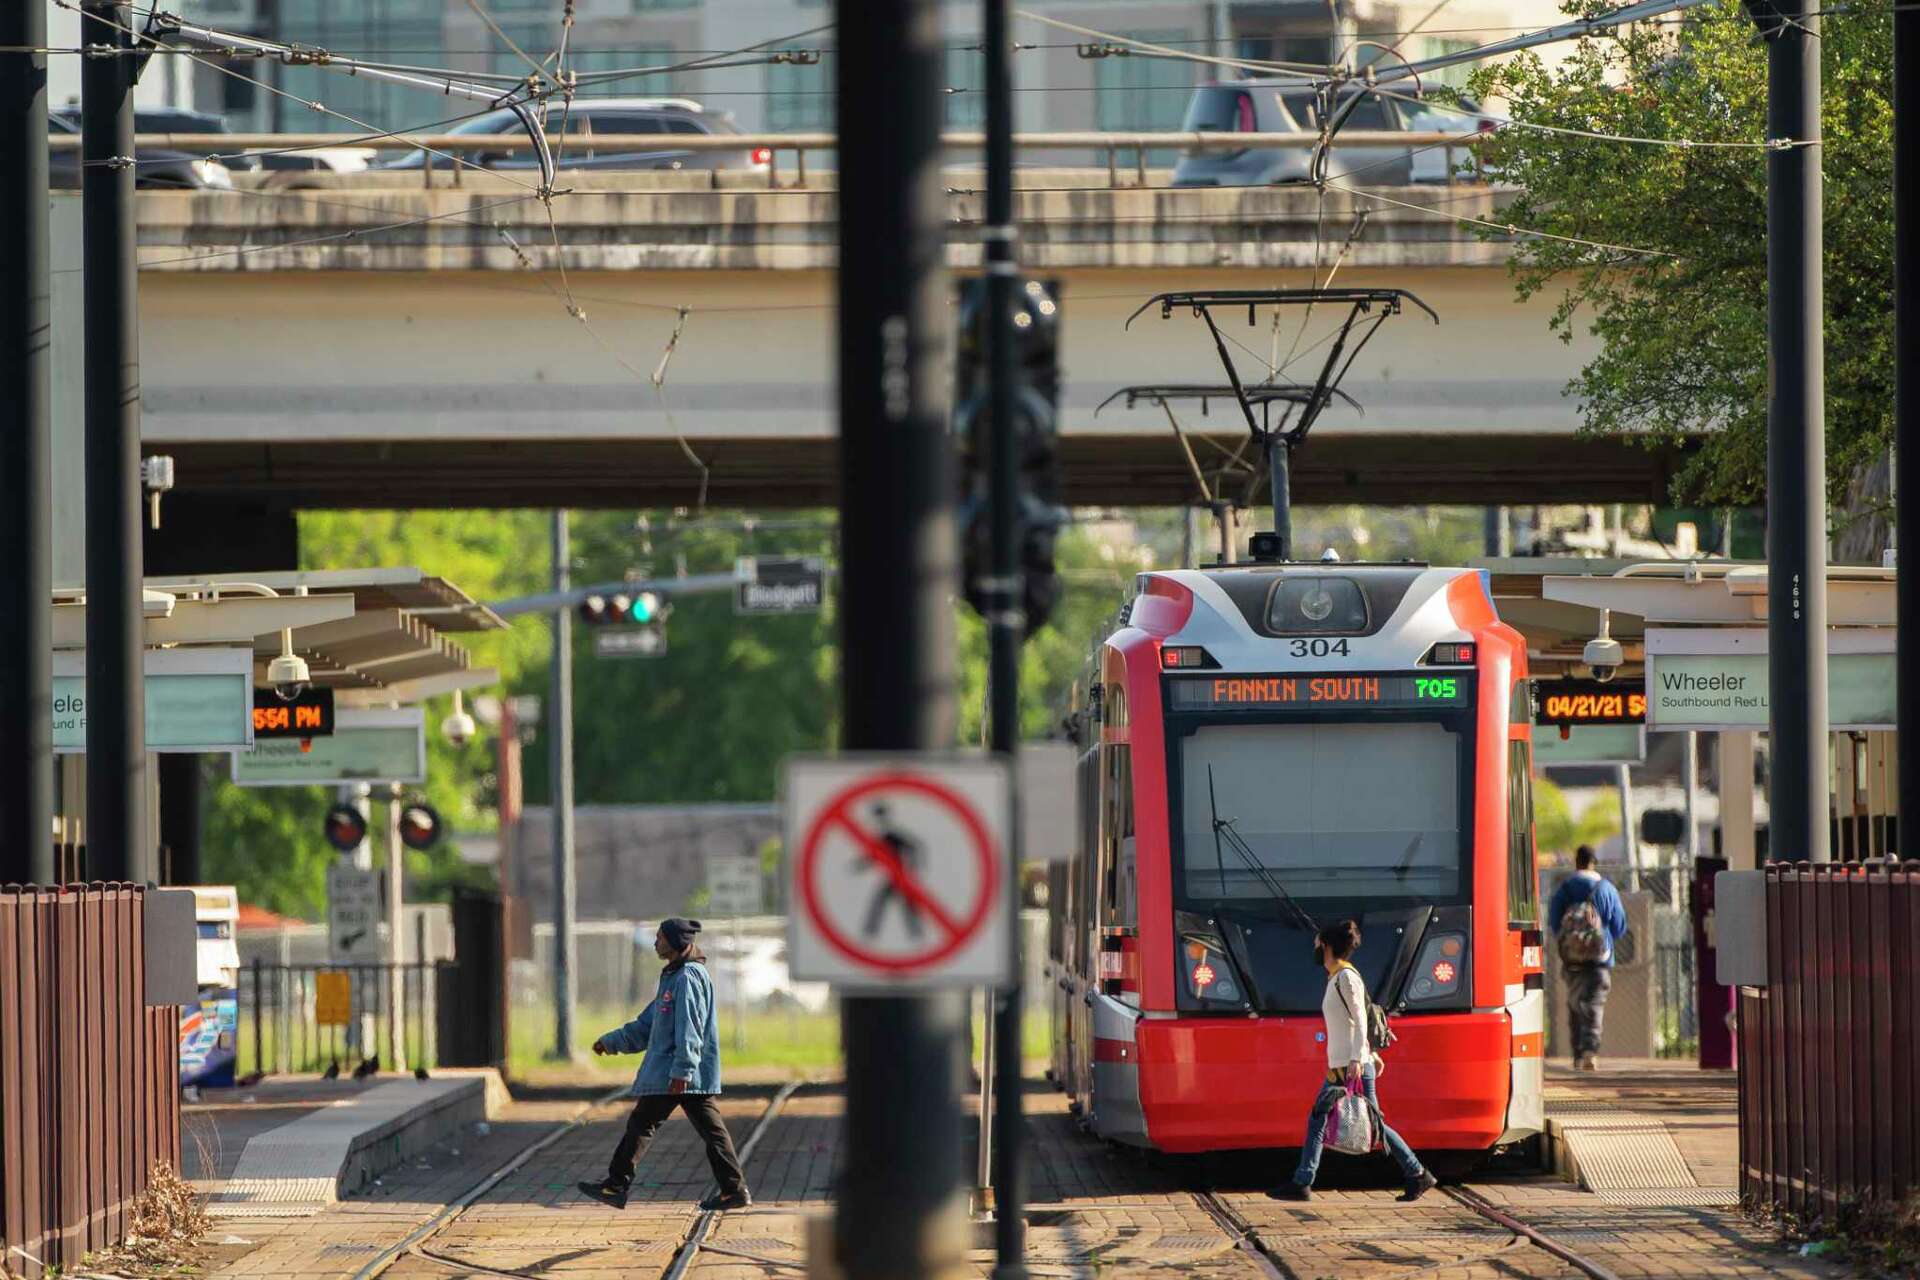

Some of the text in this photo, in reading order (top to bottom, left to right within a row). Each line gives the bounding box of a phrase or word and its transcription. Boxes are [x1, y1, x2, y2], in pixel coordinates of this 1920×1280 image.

[1289, 638, 1351, 657] 304
[1214, 678, 1379, 702] FANNIN SOUTH
[1415, 679, 1456, 698] 705
[1662, 672, 1746, 691] Wheeler
[54, 694, 83, 713] ele
[1546, 694, 1623, 717] 04/21/21
[1662, 696, 1769, 708] Southbound Red L
[296, 704, 321, 728] PM
